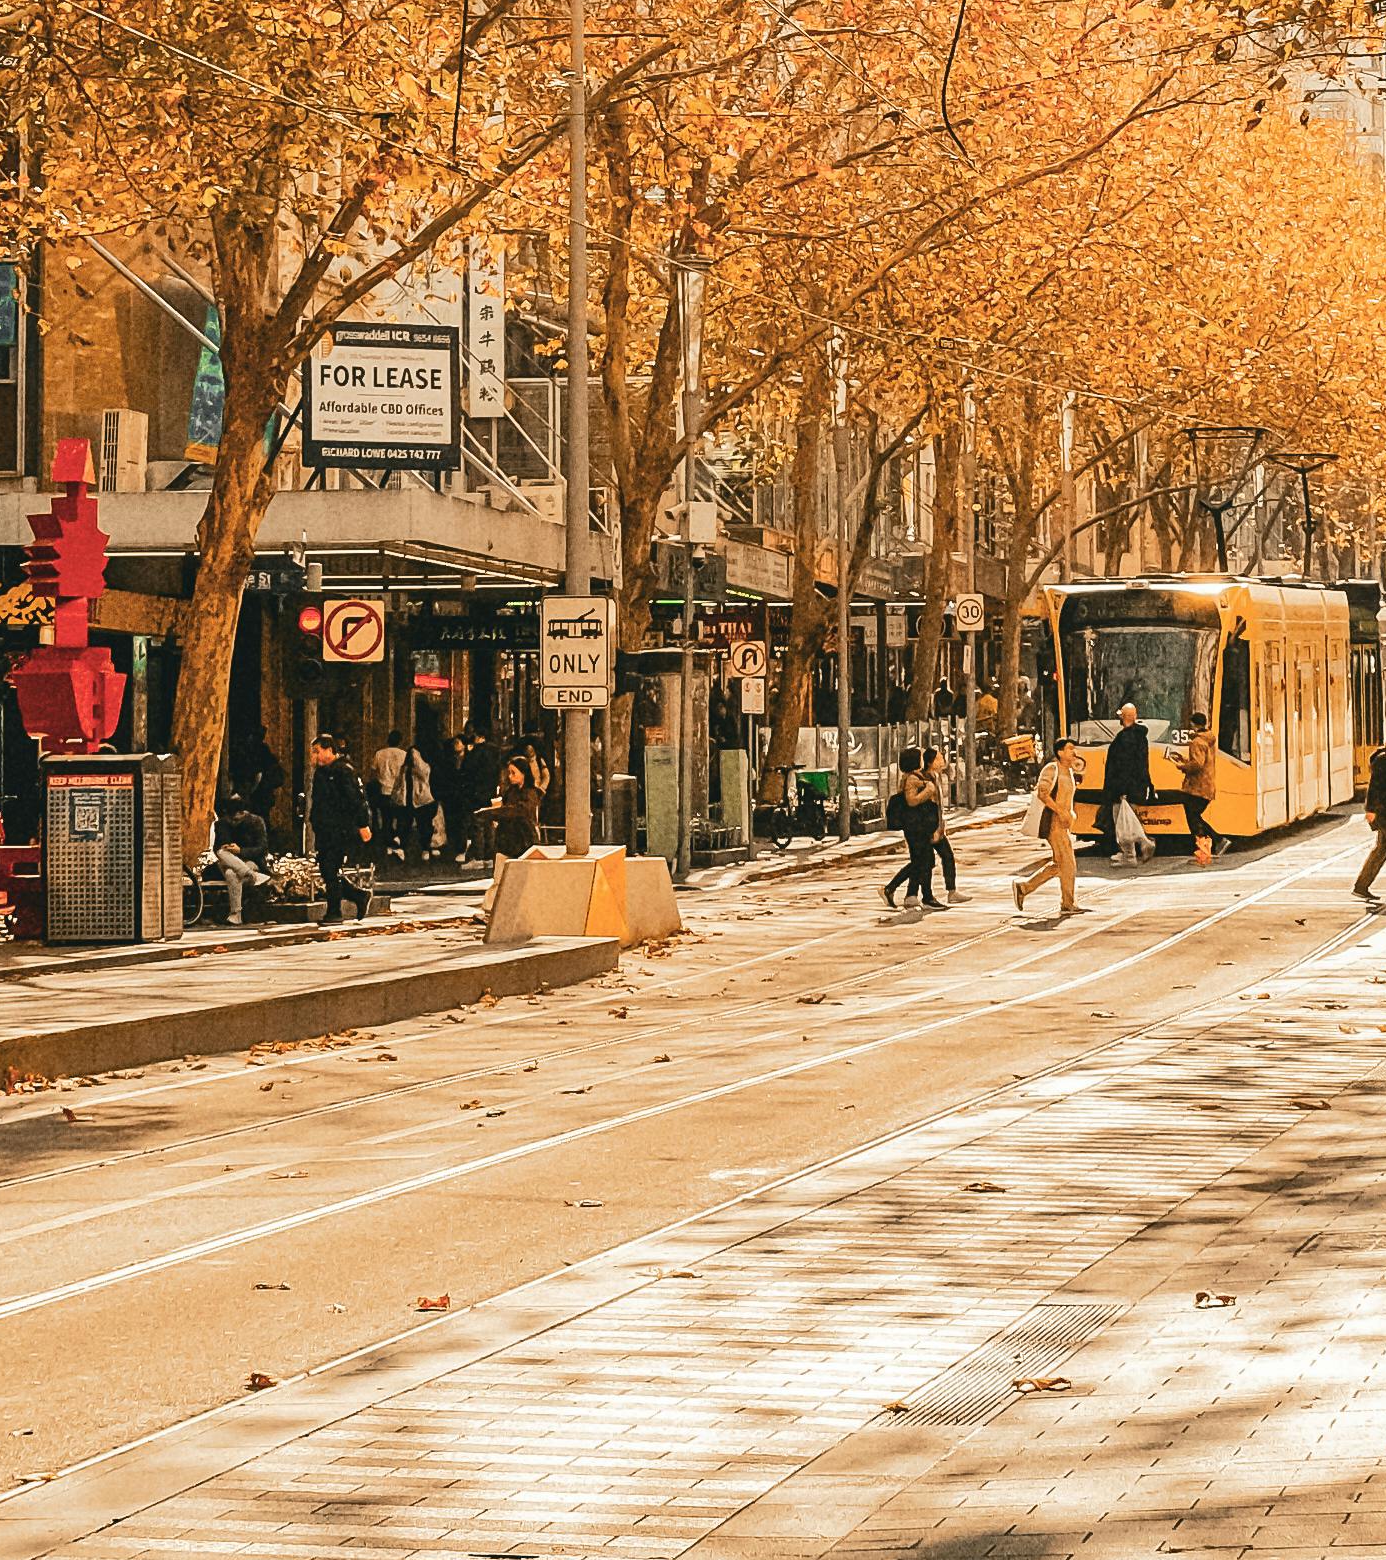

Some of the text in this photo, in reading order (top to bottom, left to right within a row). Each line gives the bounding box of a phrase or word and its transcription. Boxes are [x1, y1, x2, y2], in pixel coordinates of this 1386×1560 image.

[320, 364, 442, 390] FOR LEASE
[319, 400, 444, 416] Affordable CBD Offices
[961, 605, 980, 619] 30
[549, 653, 601, 674] ONLY
[557, 690, 593, 703] END
